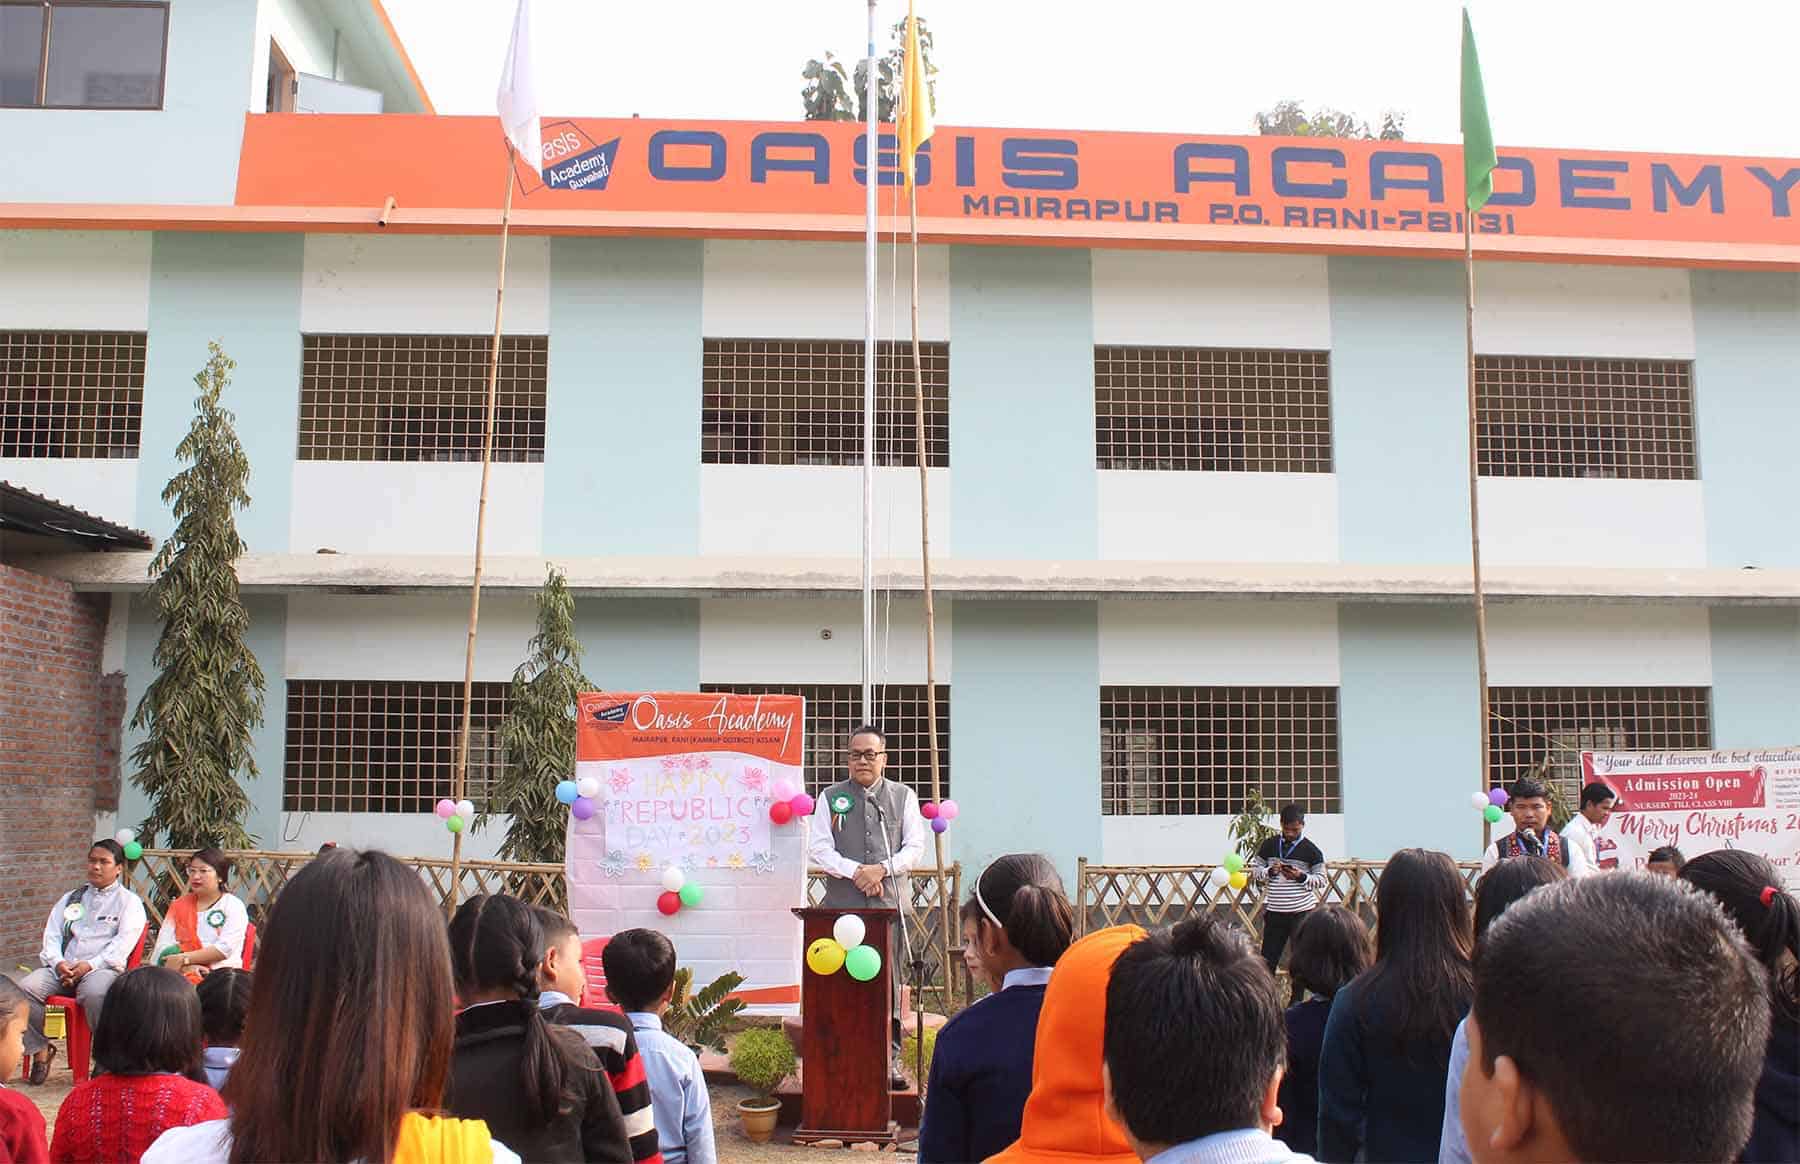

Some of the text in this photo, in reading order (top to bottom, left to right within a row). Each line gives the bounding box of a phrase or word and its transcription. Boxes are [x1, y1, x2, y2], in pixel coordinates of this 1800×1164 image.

[541, 132, 581, 161] asis
[549, 152, 607, 187] Academy
[648, 130, 1800, 217] OASIS ACADEMY
[963, 195, 1180, 223] MAIRAPUR
[1209, 203, 1270, 225] P.O.
[631, 694, 794, 758] Oasis Academy
[1636, 754, 1662, 766] child
[1666, 753, 1707, 765] deserves
[1711, 752, 1728, 764] the
[1731, 751, 1751, 763] best
[644, 770, 731, 797] HAPPY
[1624, 776, 1741, 792] Admission Open
[1633, 802, 1670, 810] NURSERY
[625, 825, 673, 849] DAY
[1615, 813, 1680, 848] Merry
[1685, 811, 1777, 840] Christmas
